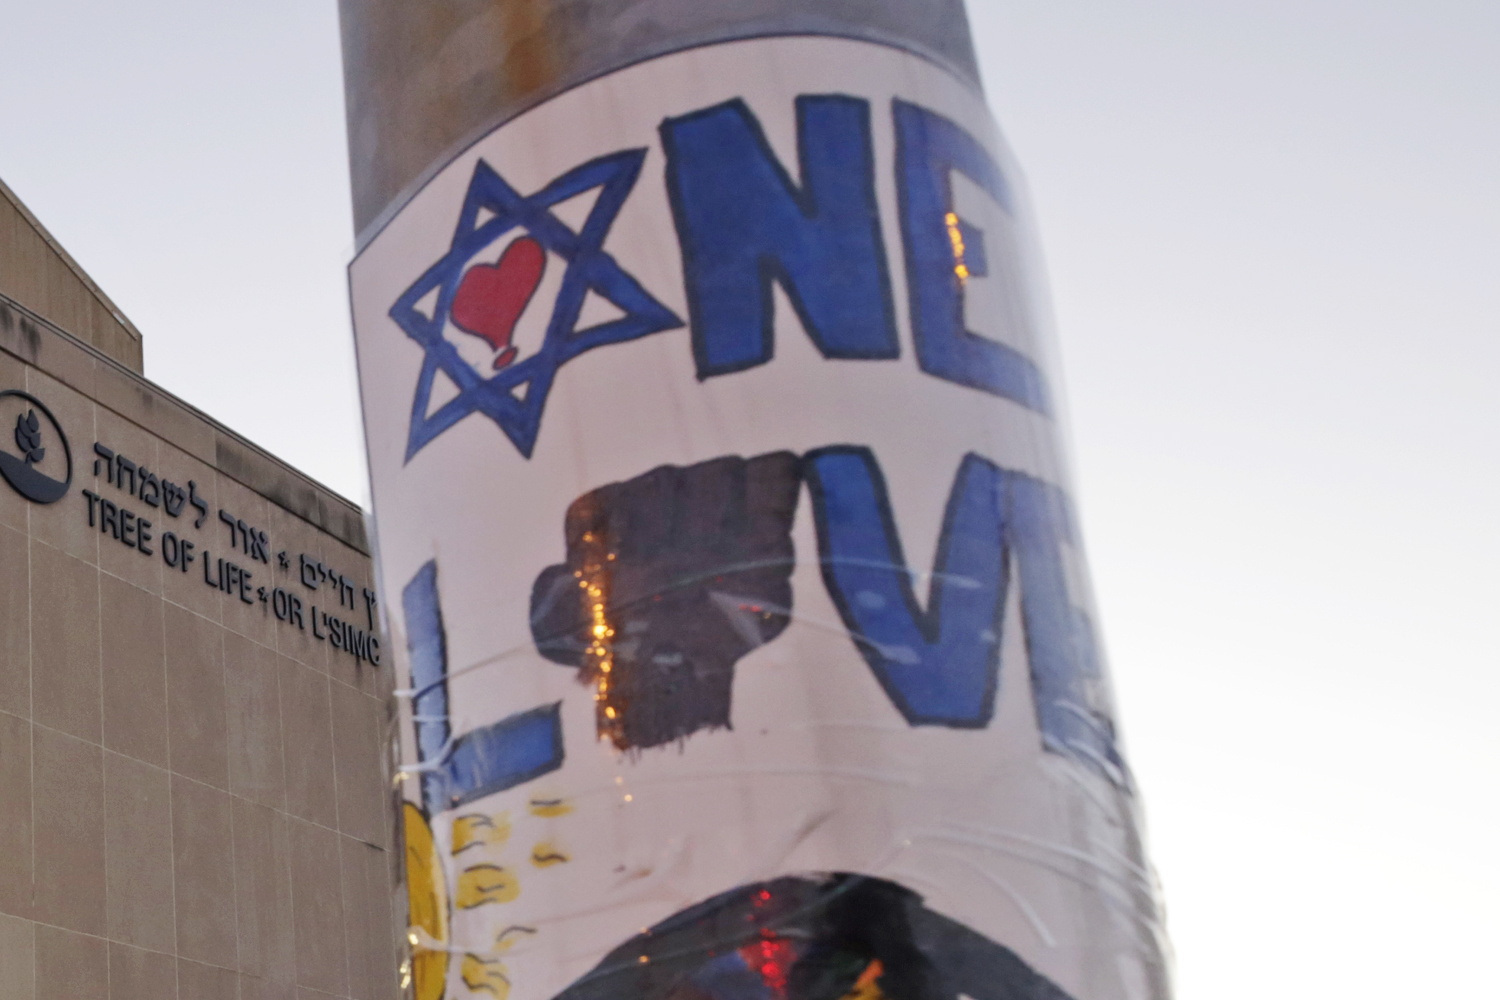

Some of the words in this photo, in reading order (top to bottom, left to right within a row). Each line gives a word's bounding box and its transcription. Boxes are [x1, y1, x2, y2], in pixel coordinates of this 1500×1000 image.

[93, 441, 209, 530] לשמחה
[81, 488, 154, 558] TREE
[161, 530, 195, 573] OF
[203, 549, 254, 605] LIFE
[272, 586, 305, 631] OR
[218, 508, 269, 565] אור
